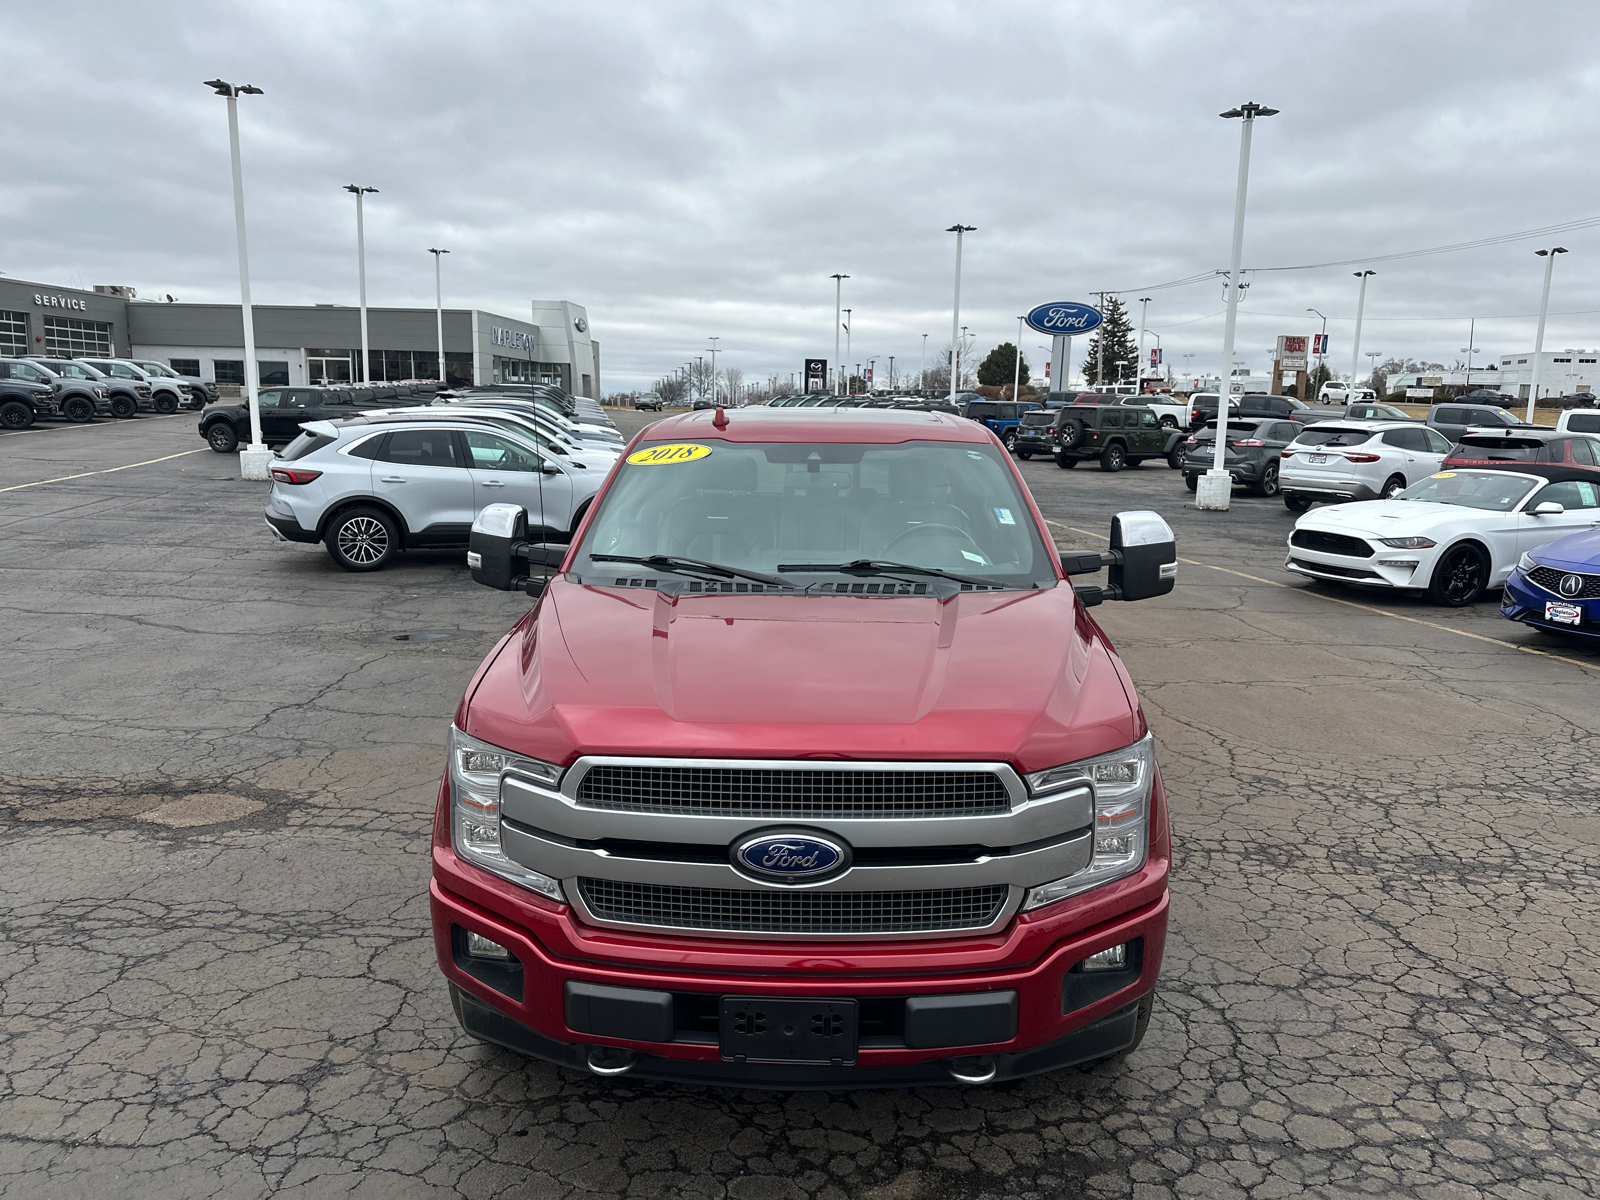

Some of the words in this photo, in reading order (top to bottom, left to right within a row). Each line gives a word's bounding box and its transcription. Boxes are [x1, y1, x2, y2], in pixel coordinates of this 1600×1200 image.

[34, 294, 86, 311] SERVICE
[1043, 307, 1089, 328] Ford
[492, 326, 535, 352] NAPLETON
[637, 446, 699, 462] 2018
[1552, 608, 1575, 616] Napleton
[762, 843, 820, 868] Ford
